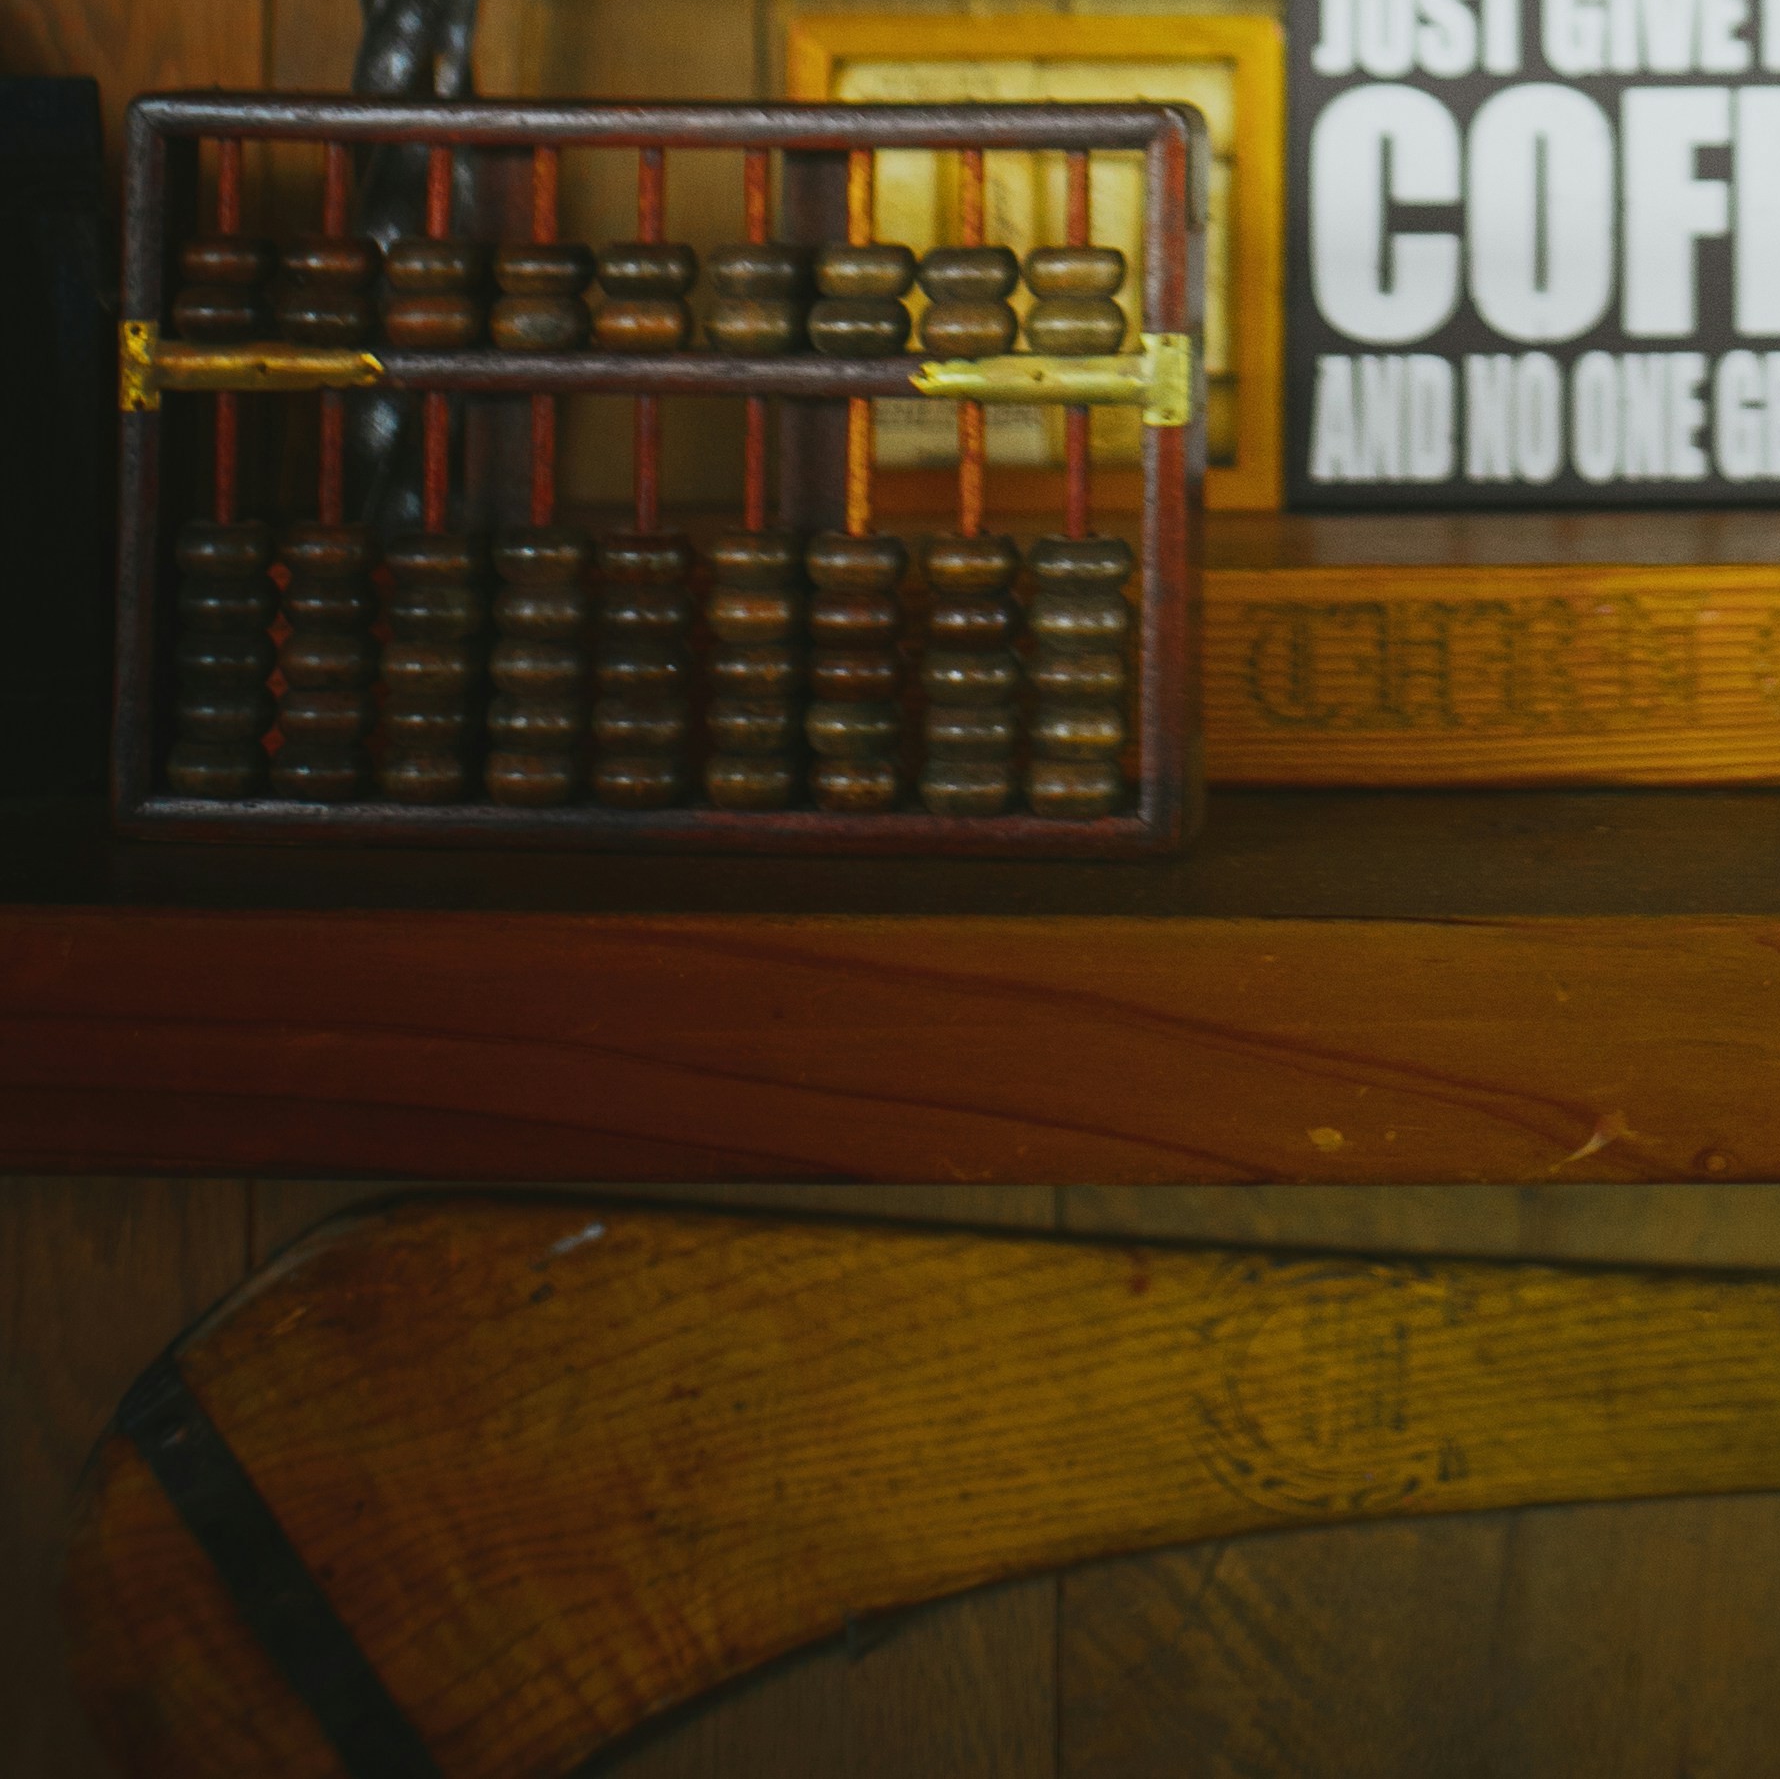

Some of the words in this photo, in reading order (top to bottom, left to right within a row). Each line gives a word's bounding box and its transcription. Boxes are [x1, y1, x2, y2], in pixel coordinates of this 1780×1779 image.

[1310, 353, 1457, 482] AND
[1464, 351, 1565, 482] NO
[1572, 350, 1710, 482] ONE
